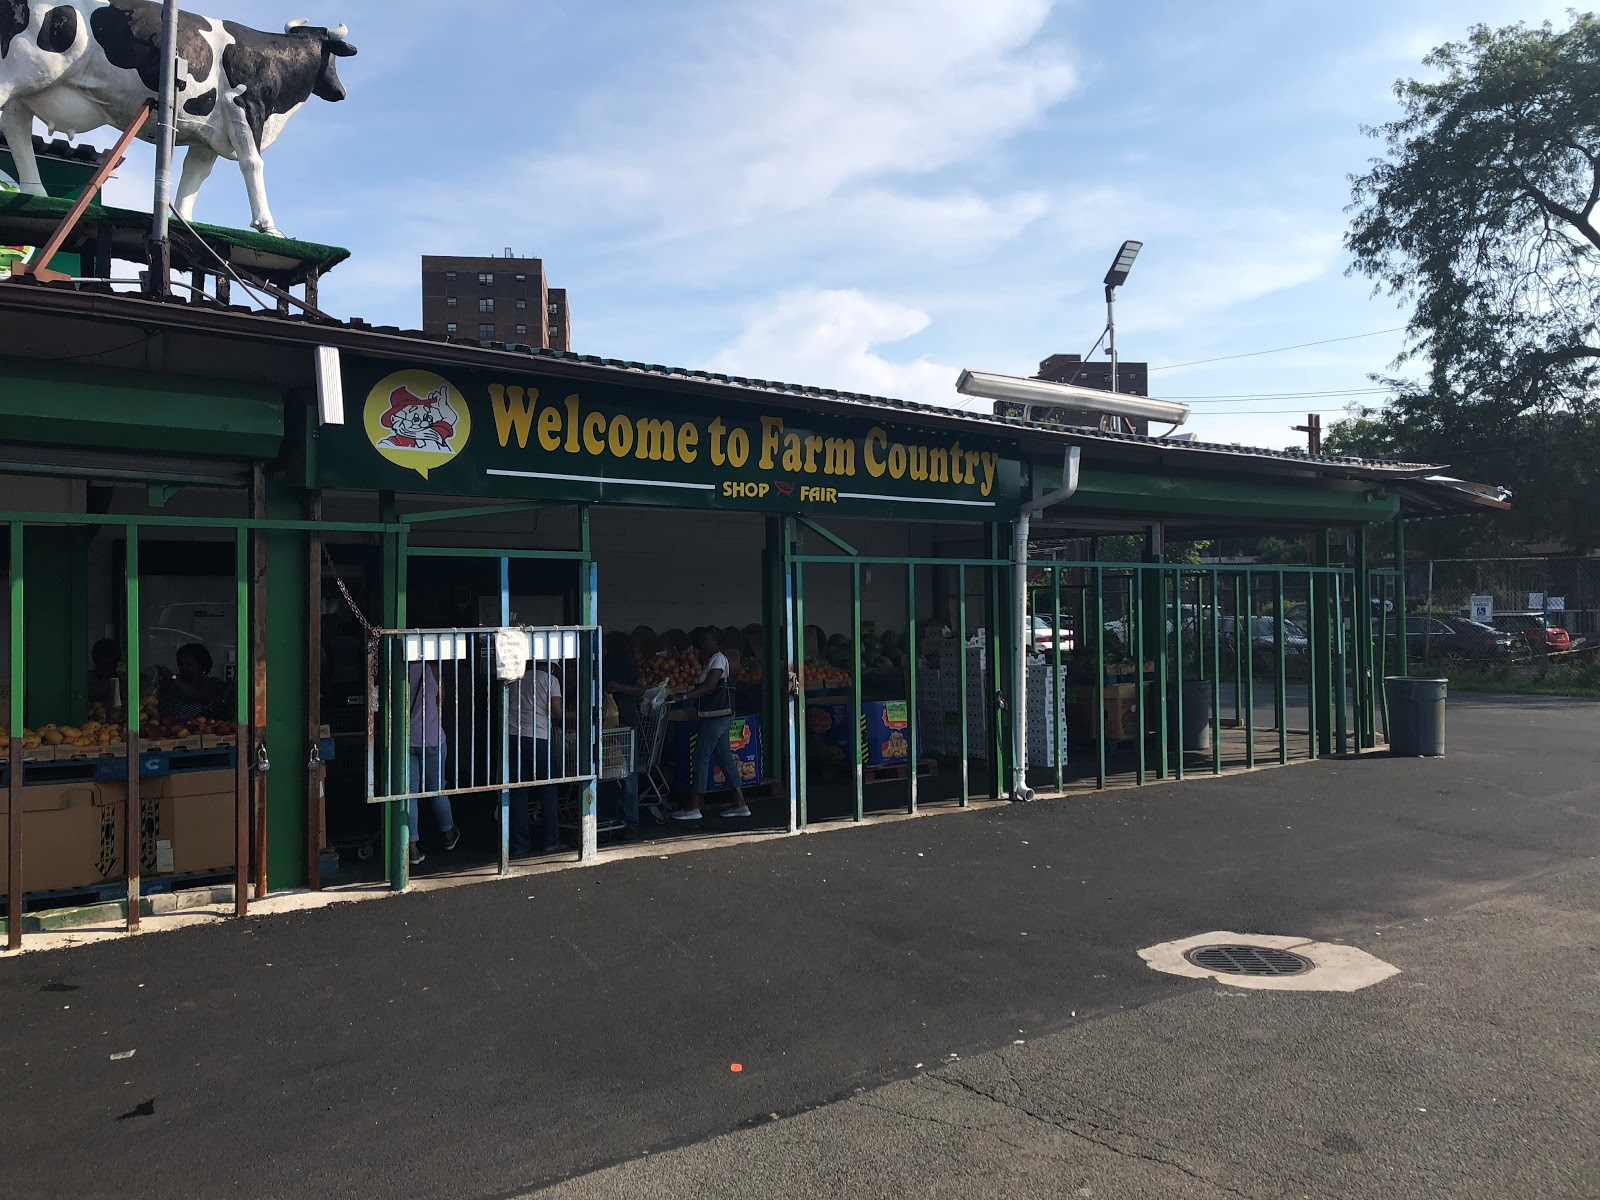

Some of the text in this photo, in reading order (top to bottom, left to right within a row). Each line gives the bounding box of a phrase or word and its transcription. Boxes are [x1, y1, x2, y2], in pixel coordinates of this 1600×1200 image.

[488, 383, 998, 497] Welcome to Farm Country
[722, 481, 837, 504] SHOP FAIR
